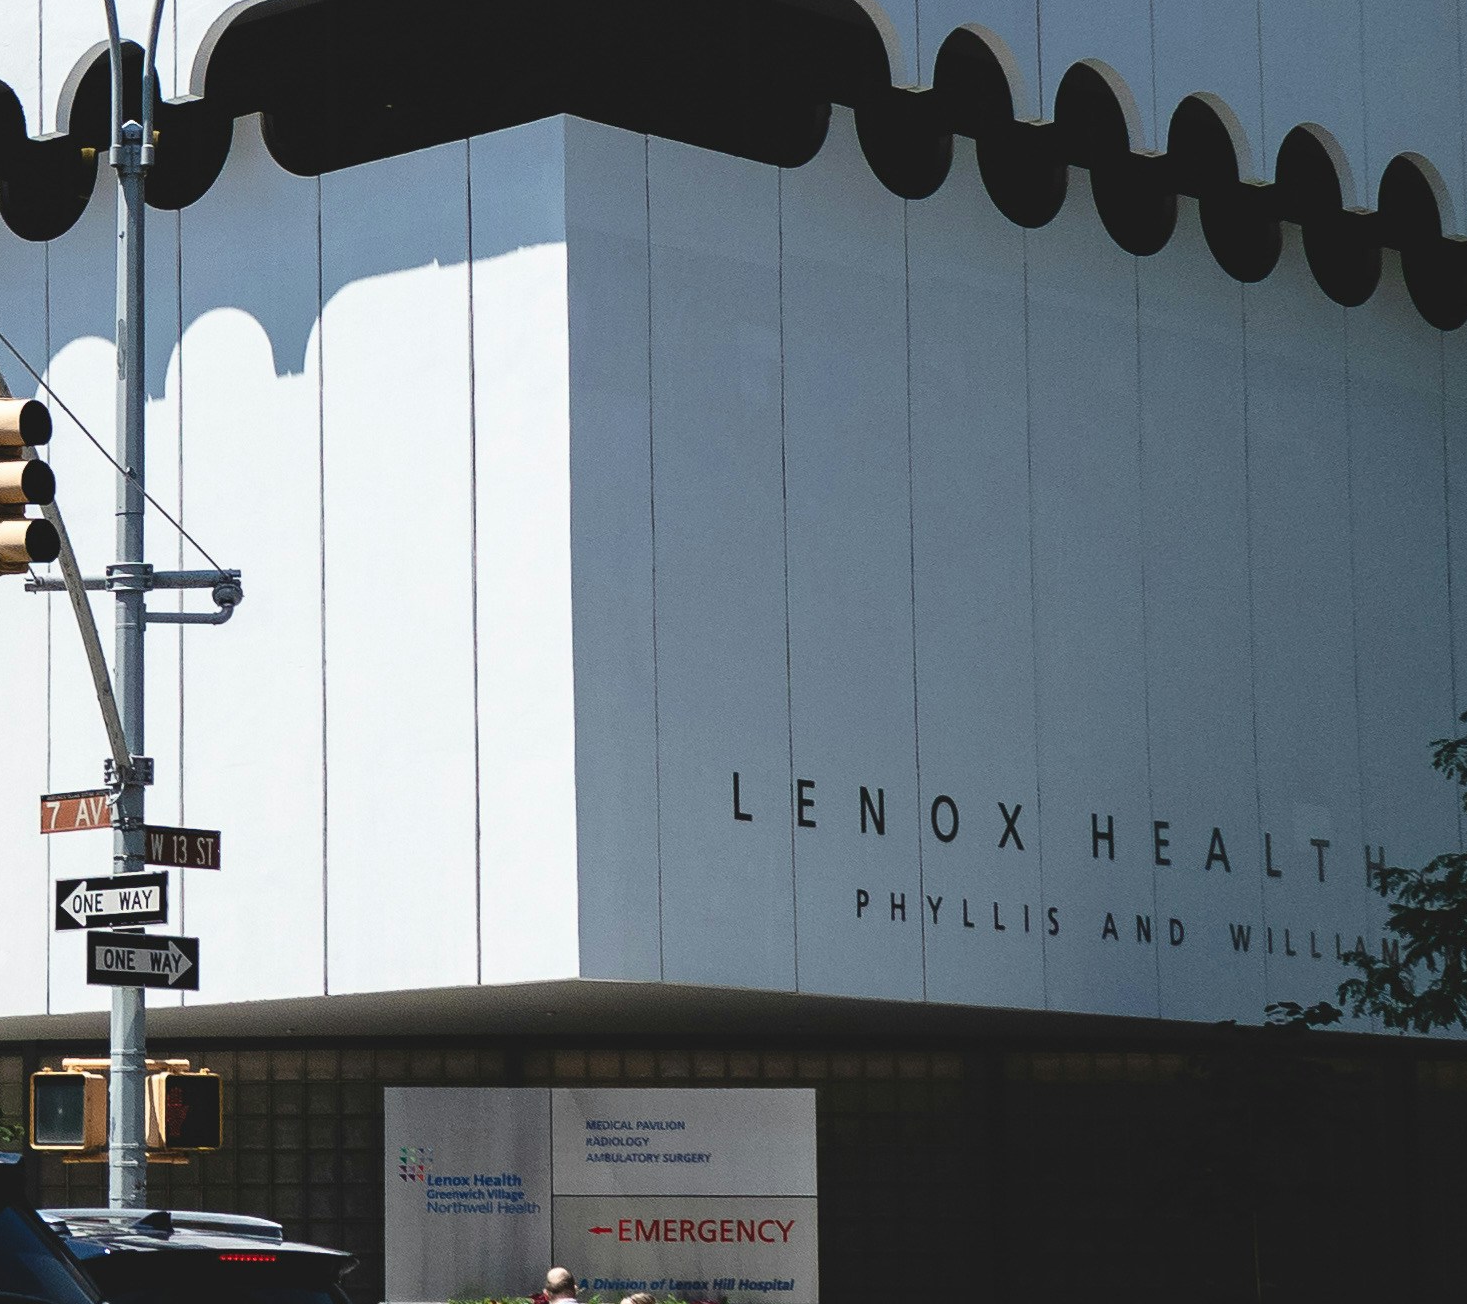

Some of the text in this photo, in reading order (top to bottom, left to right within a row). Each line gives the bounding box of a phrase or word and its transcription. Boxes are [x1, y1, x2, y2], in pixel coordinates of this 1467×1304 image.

[46, 801, 61, 829] 7
[732, 771, 1387, 891] LENOX HEALTH
[150, 833, 215, 867] W 13 ST
[72, 889, 154, 914] ONE WAY
[856, 889, 1061, 936] PHYLLIS
[1102, 911, 1185, 948] AND
[103, 948, 183, 974] ONE WAY
[585, 1119, 686, 1131] MEDICAL PAVILION
[585, 1136, 649, 1147] RADIOLOGY
[585, 1152, 711, 1164] AMBULATORY SURGERY
[427, 1173, 522, 1187] Lenox Health
[426, 1188, 525, 1203] Greenwich Village
[426, 1201, 541, 1214] Northwell Health
[618, 1218, 795, 1243] EMERGENCY
[579, 1278, 795, 1294] A Division of Lenox Hill Hospital
